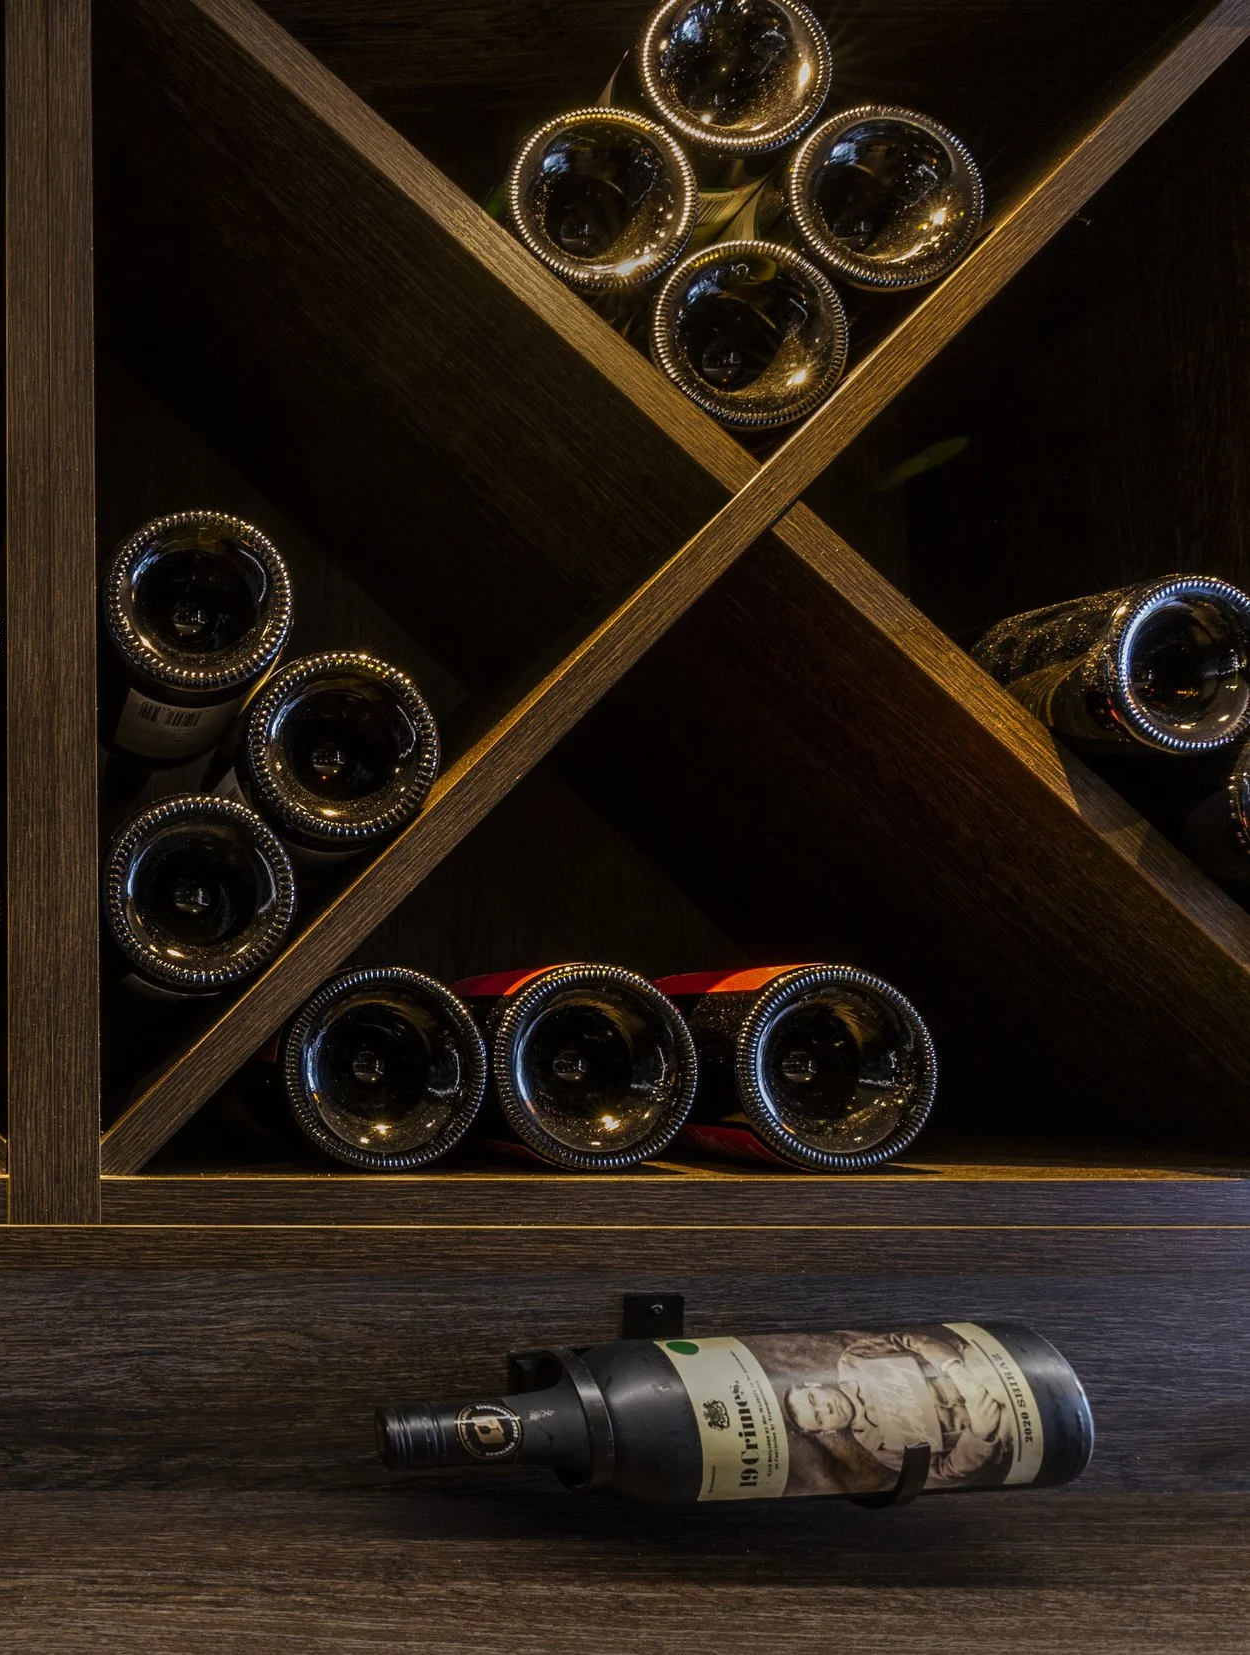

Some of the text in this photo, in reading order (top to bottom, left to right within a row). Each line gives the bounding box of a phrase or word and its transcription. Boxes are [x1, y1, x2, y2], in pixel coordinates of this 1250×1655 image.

[989, 1352, 1033, 1443] 2020 SHIRAZ
[738, 1467, 759, 1488] 19
